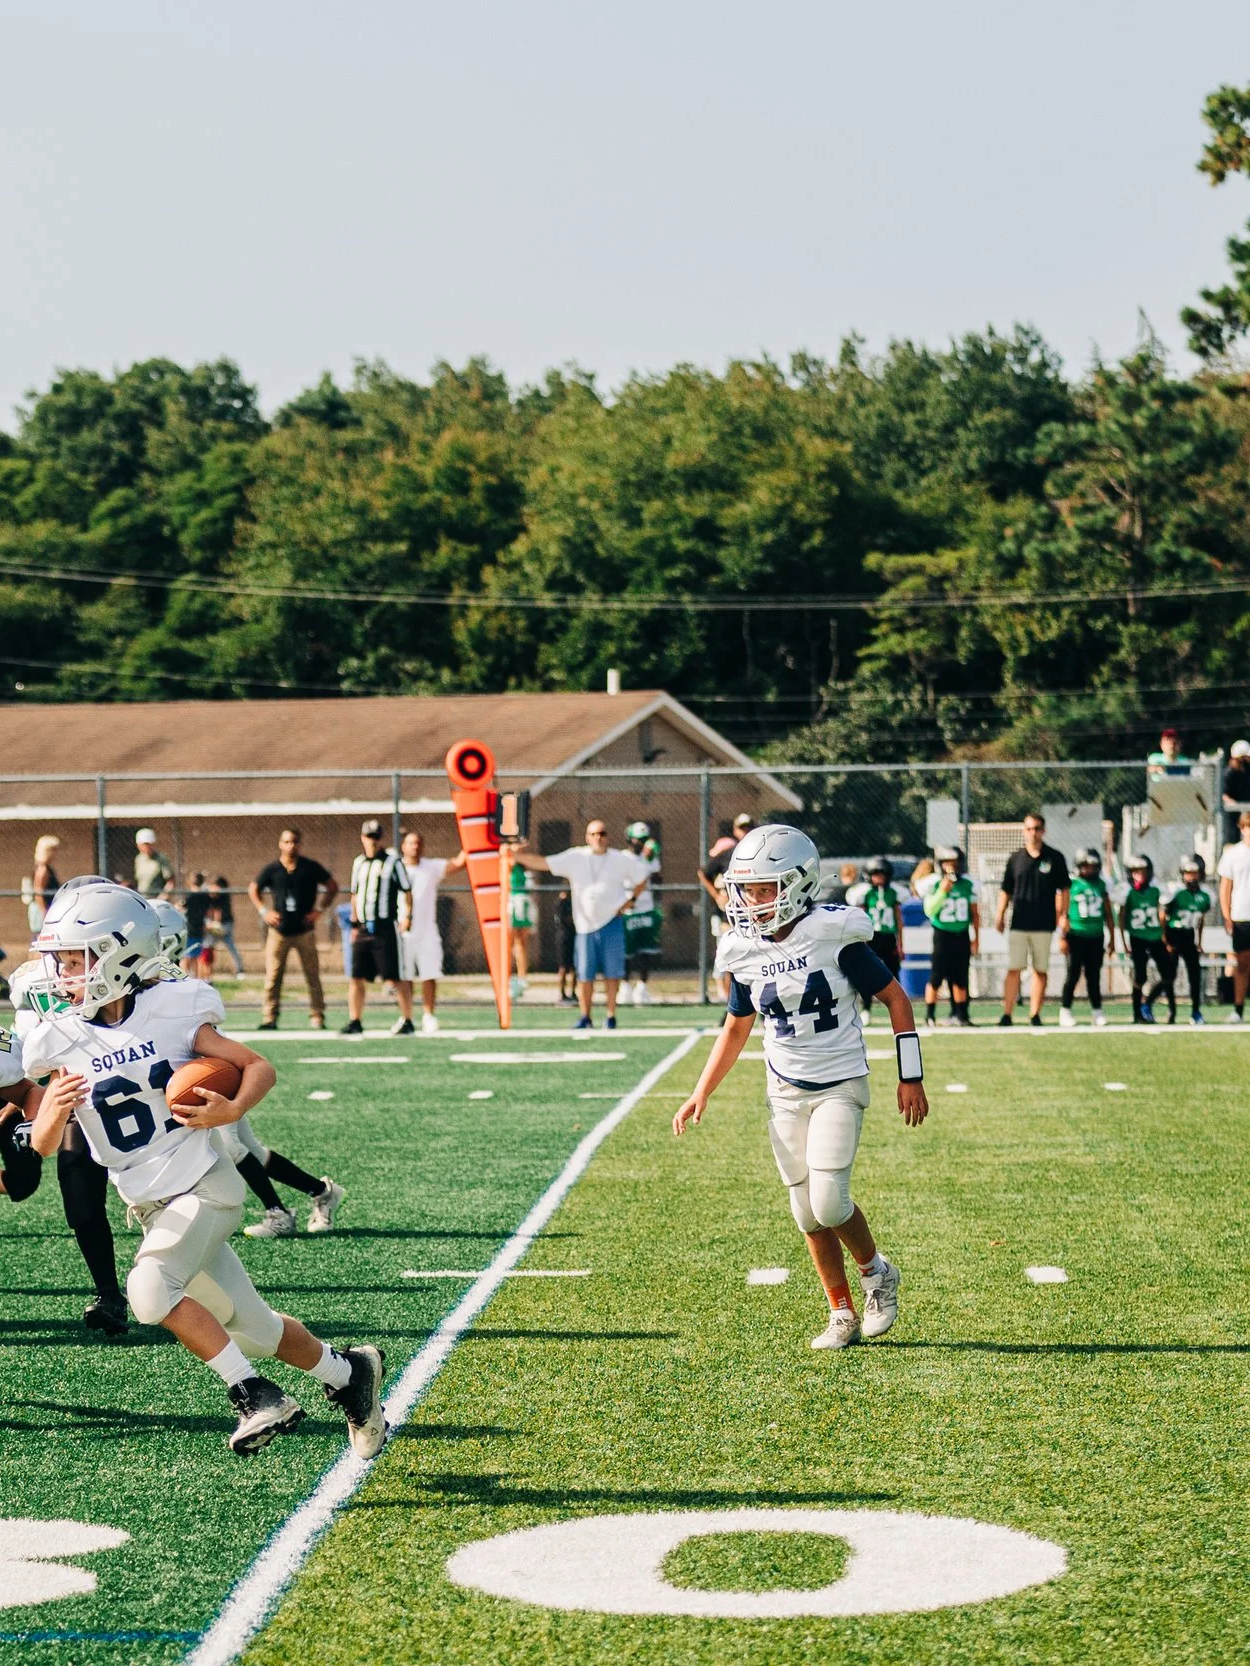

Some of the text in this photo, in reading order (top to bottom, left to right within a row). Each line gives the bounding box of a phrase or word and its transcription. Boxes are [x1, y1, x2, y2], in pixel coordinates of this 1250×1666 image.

[761, 956, 808, 977] SQUAN
[759, 969, 840, 1039] 44
[91, 1040, 157, 1073] SQUAN
